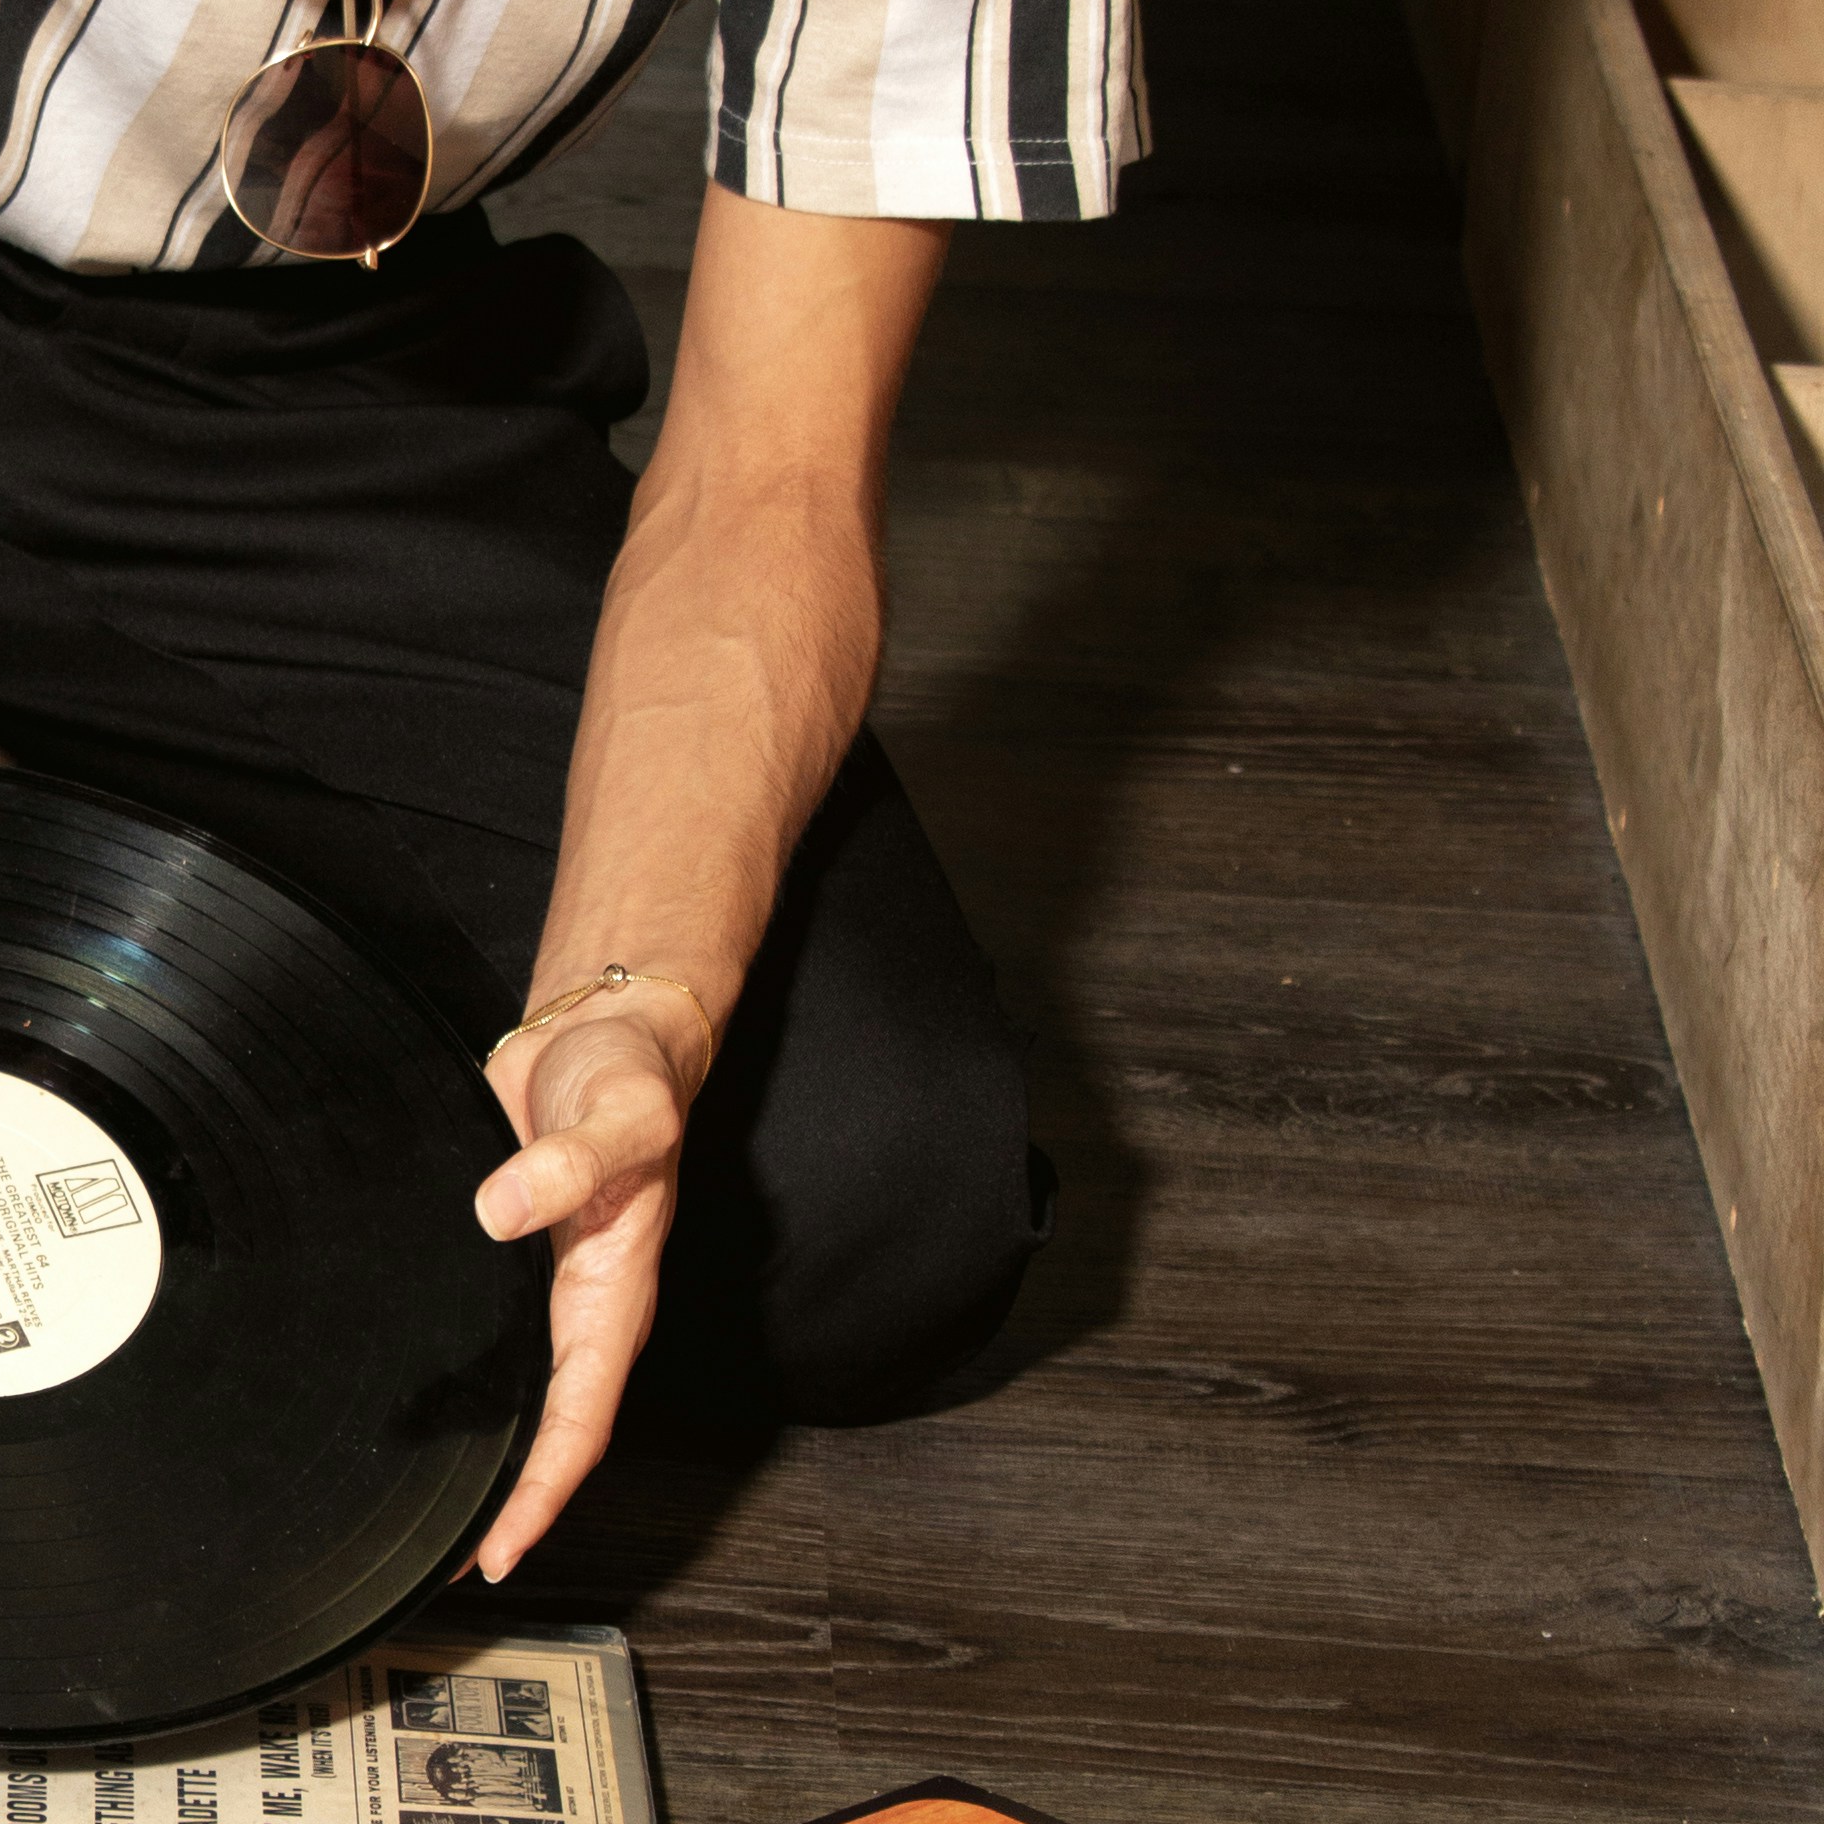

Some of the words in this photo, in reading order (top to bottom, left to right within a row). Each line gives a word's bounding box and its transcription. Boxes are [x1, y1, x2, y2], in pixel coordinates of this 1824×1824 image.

[3, 1184, 41, 1248] GREATEST
[34, 1254, 50, 1268] 64
[1, 1249, 25, 1289] MARTHA
[19, 1291, 42, 1328] REEVES
[22, 1261, 44, 1290] HITS
[363, 1714, 378, 1763] LISTENING
[259, 1732, 301, 1779] WAKE
[311, 1749, 336, 1778] (WHEN
[367, 1766, 381, 1792] YOUR
[262, 1788, 309, 1816] ME,
[369, 1795, 382, 1816] FOR
